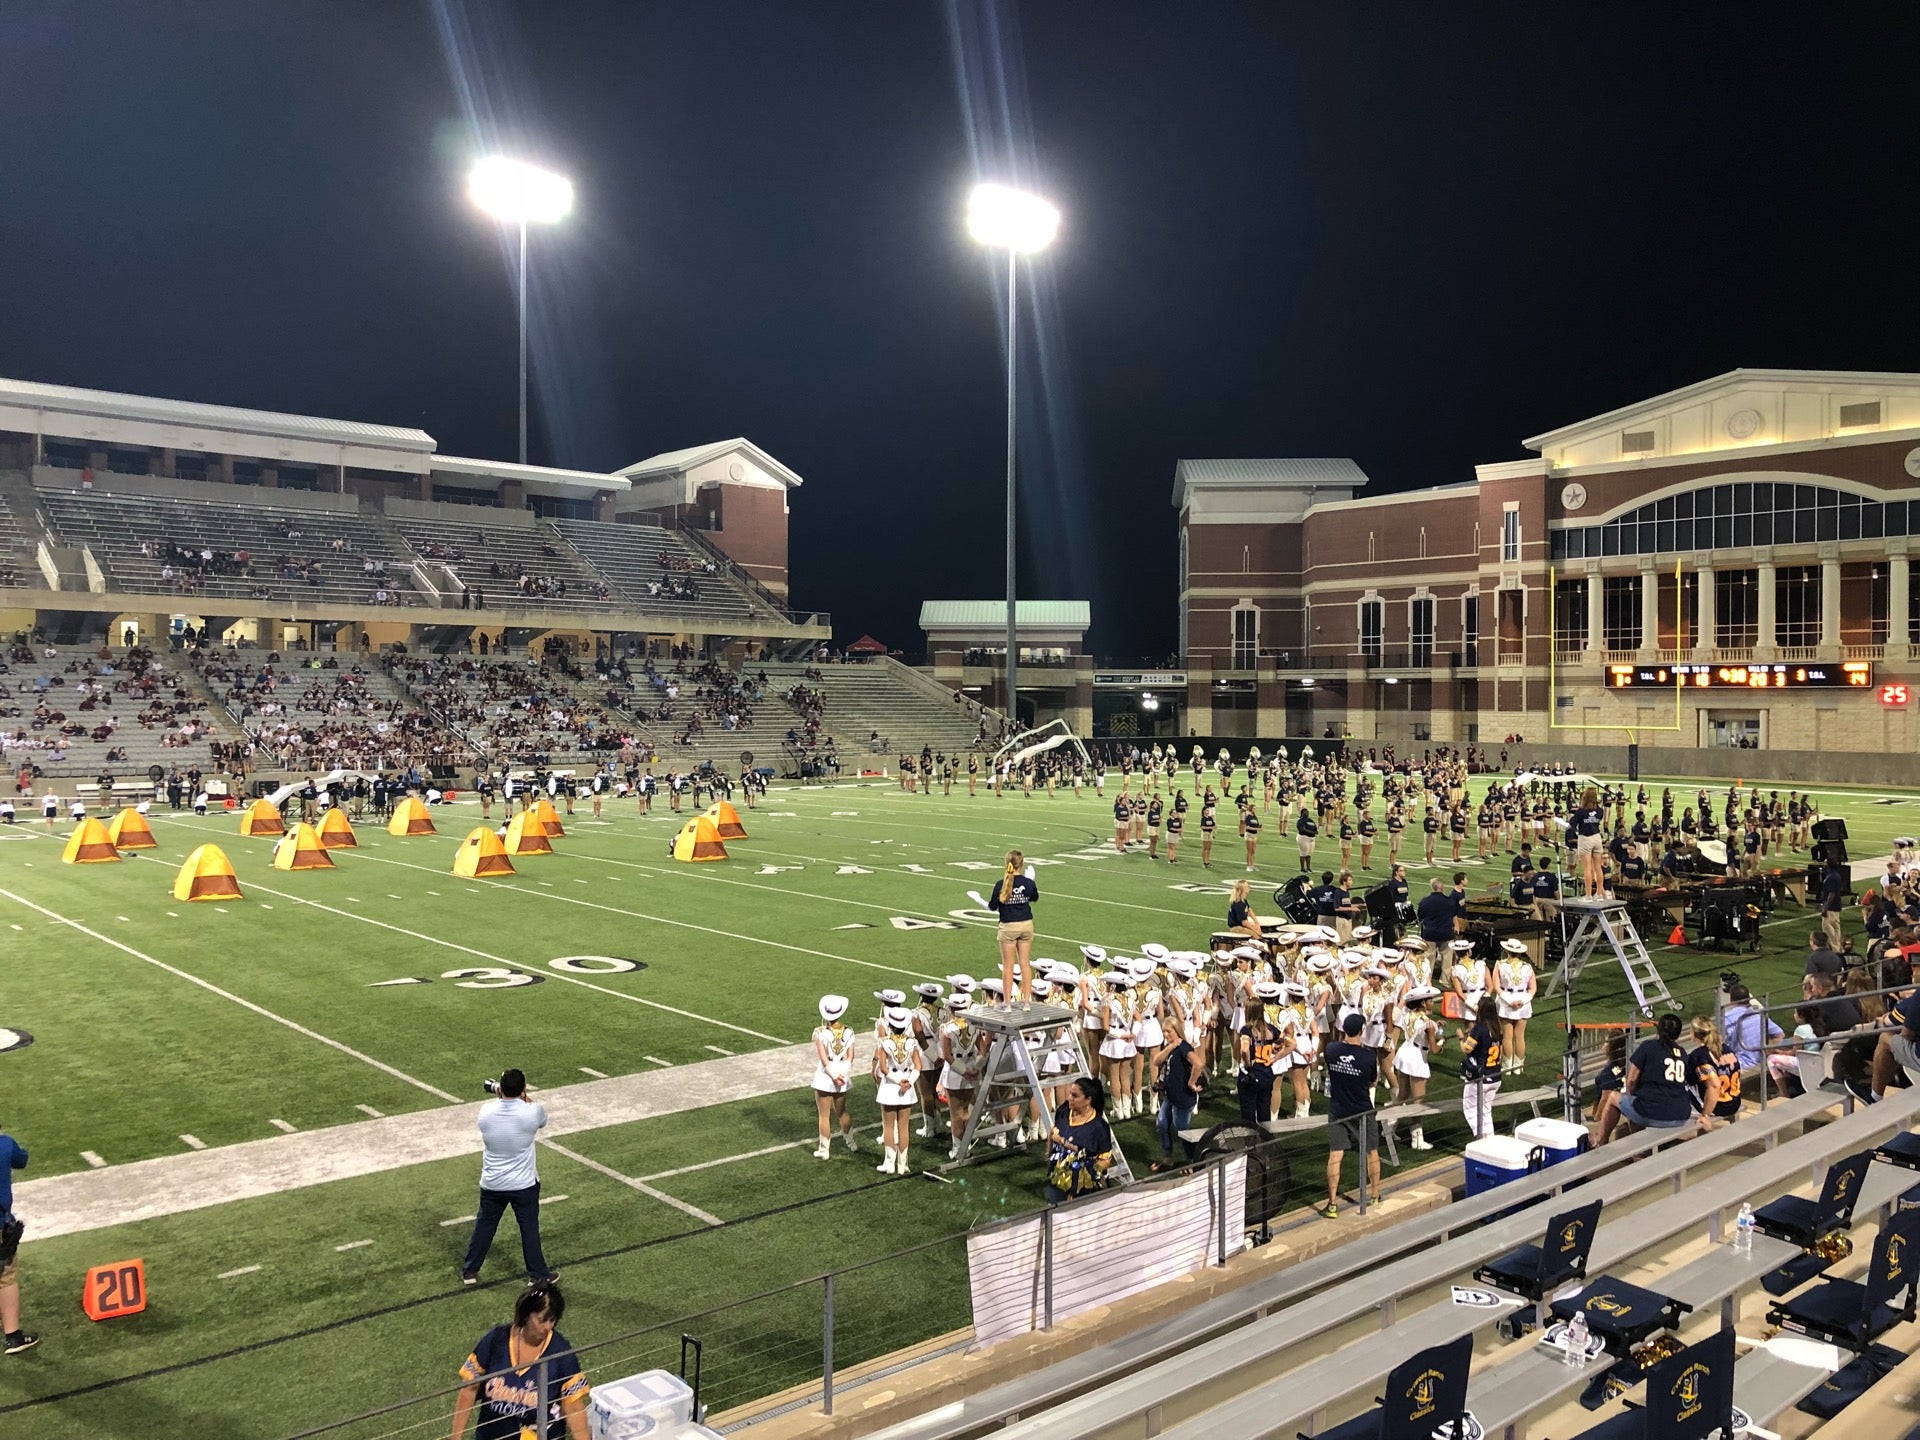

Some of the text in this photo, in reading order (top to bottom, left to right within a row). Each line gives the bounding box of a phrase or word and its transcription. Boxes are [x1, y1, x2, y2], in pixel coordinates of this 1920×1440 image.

[1883, 686, 1907, 703] 25
[440, 955, 648, 989] 30
[1448, 995, 1459, 1012] 4
[1663, 1057, 1686, 1083] 20
[96, 1266, 142, 1312] 20
